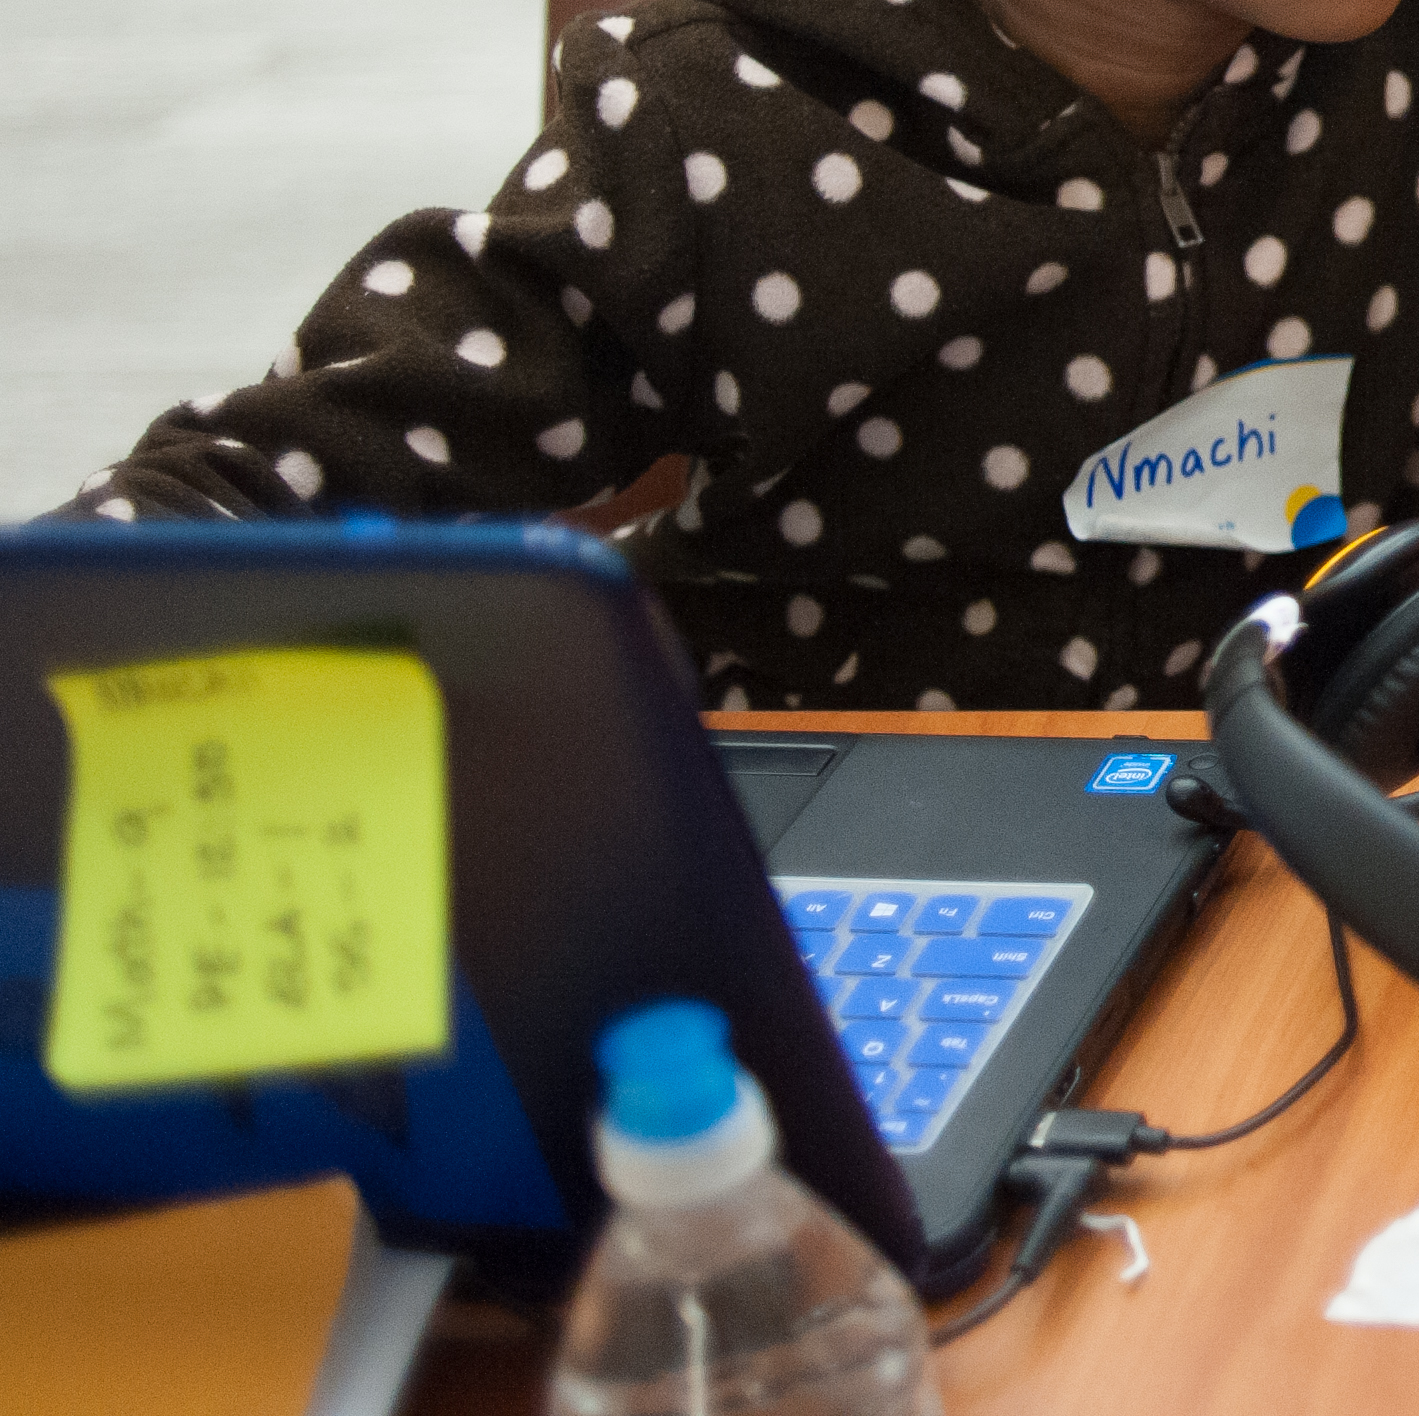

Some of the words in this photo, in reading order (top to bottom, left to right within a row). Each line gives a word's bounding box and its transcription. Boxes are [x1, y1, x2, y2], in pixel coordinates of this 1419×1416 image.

[1085, 413, 1277, 510] Nmachi
[1112, 772, 1146, 781] intel
[806, 903, 828, 913] Alt
[938, 907, 959, 917] Fn
[1028, 910, 1056, 921] Ctrl
[872, 954, 892, 968] Z
[992, 950, 1029, 962] Shift
[879, 999, 898, 1012] A
[942, 994, 999, 1007] CapsLk
[861, 1040, 885, 1056] Q
[940, 1037, 968, 1050] Tab
